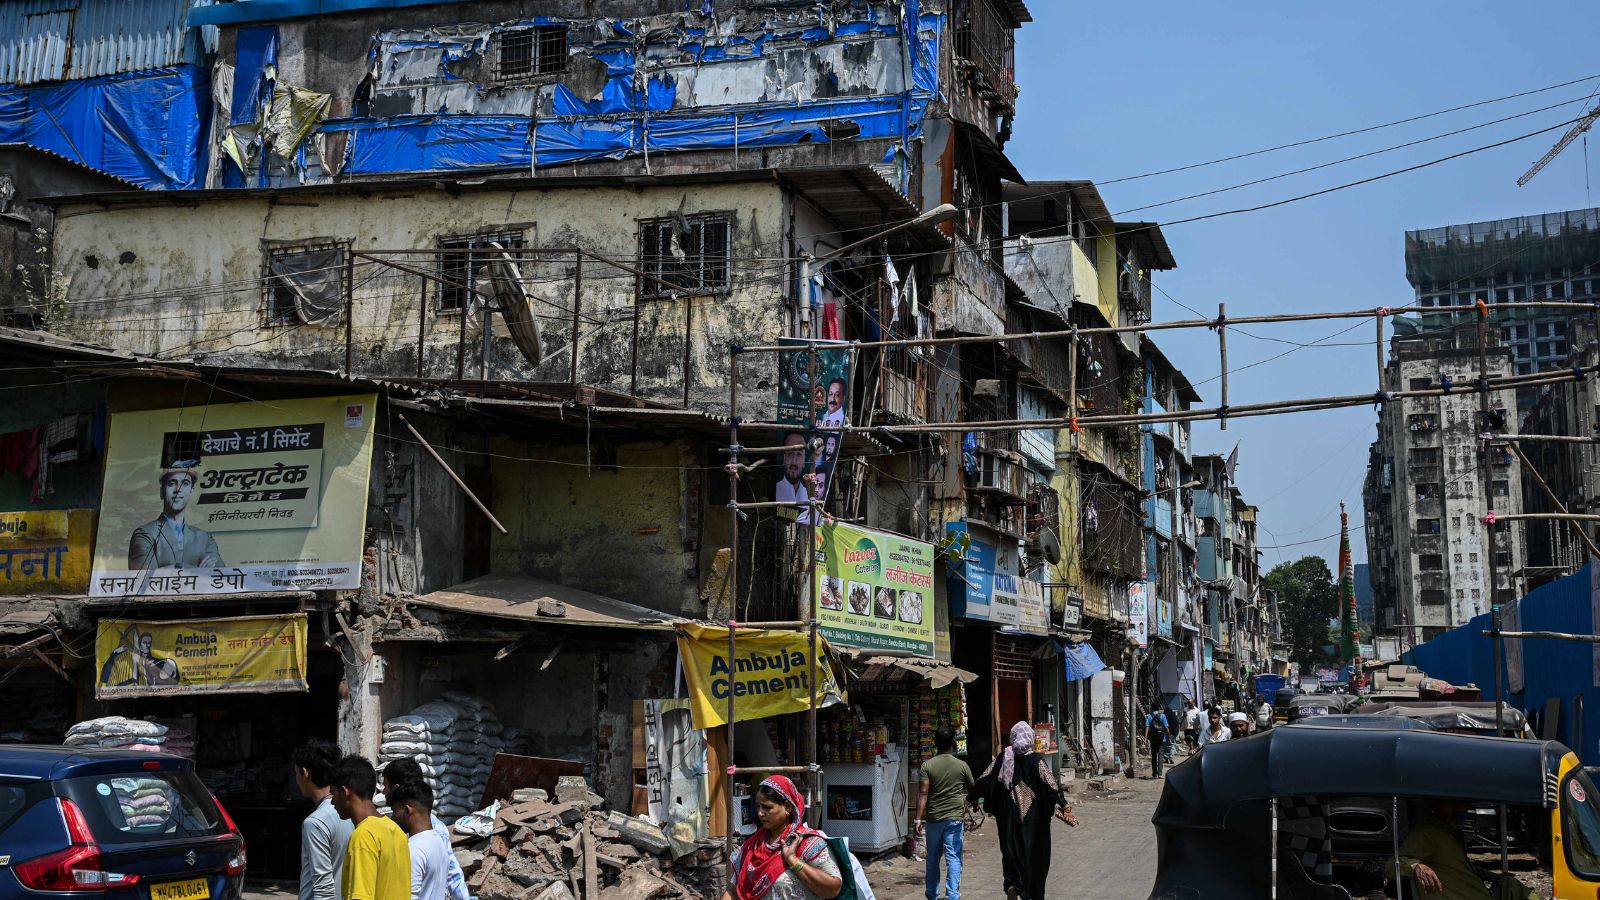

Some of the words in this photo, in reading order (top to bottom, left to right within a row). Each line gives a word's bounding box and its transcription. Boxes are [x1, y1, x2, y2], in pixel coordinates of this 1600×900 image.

[203, 432, 242, 453] देशाचे
[273, 428, 311, 451] सिमेंट
[267, 508, 295, 521] निवड
[100, 577, 137, 593] सना
[149, 569, 198, 593] लाईम
[211, 568, 247, 591] डेपो
[994, 572, 1018, 595] NATIONAL
[176, 632, 217, 647] Ambuja
[227, 638, 249, 650] सना
[175, 646, 218, 658] Cement
[710, 649, 806, 676] Ambuja
[711, 671, 809, 700] Cement
[156, 881, 208, 900] MH47BL0461
